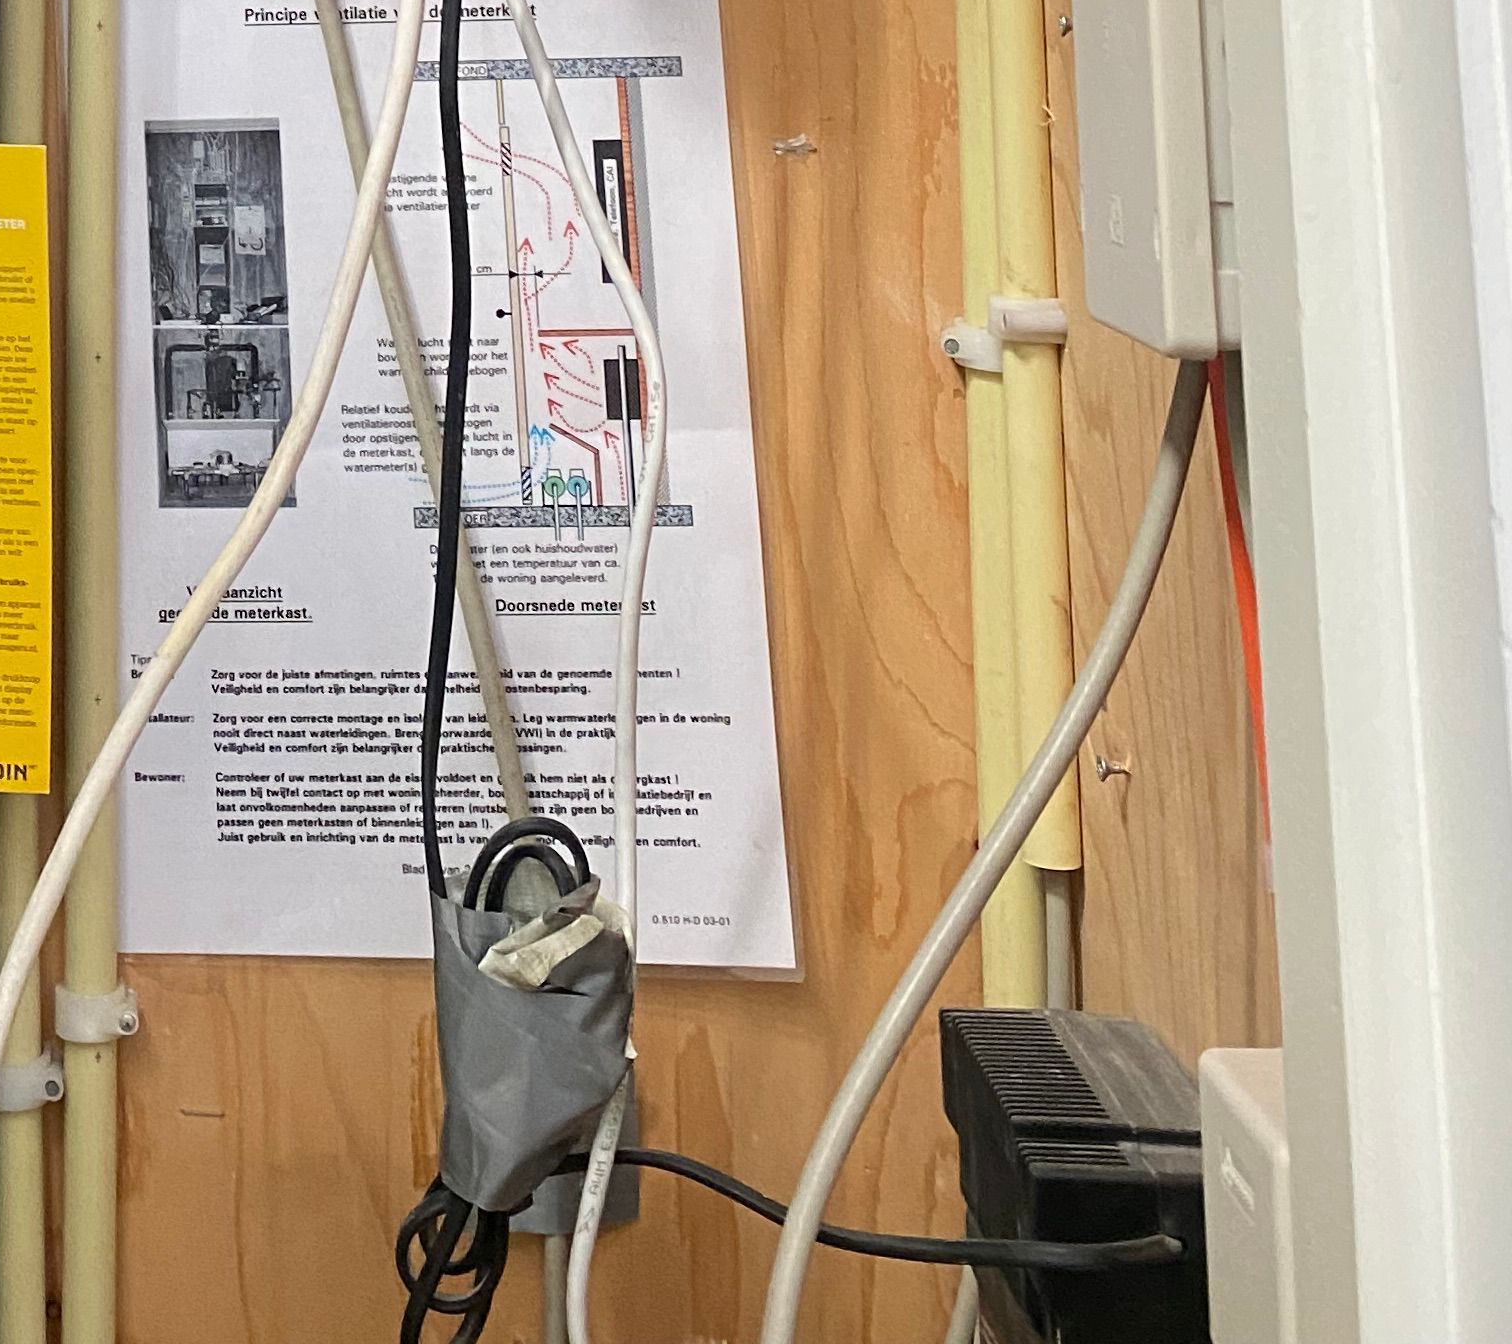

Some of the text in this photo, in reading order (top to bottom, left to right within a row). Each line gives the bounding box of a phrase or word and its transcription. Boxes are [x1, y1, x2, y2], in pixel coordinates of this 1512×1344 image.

[245, 8, 307, 24] Principe
[491, 352, 508, 361] het
[341, 405, 380, 414] Relatief
[342, 432, 499, 443] door lucht
[343, 447, 514, 458] de langs de
[512, 543, 618, 554] ook huishoudwater)
[581, 559, 601, 568] van
[498, 573, 608, 584] woning aangeleverd.
[495, 599, 656, 612] Doorsnede meterst
[234, 607, 312, 620] meterkast.
[211, 669, 612, 681] Zorg voor de juiste van de genoemde
[211, 684, 410, 696] Veiligheid en comfort belangrijker
[213, 714, 731, 726] Zorg voor een correcte montage en woning
[213, 729, 390, 740] nooit direct naast waterleidingen.
[214, 743, 495, 755] Veiligheid en comfort belangrijker praktische
[134, 773, 185, 782] Bewoner:
[215, 773, 588, 784] Controleer of uw meterkast aan de voldoet hem niet
[216, 787, 384, 800] Neem bij contact op met
[216, 802, 396, 813] laat onvolkomenheden aanpassen
[217, 817, 353, 829] passen geen meterkasten
[218, 832, 379, 845] Juist gebruik en inrichting van
